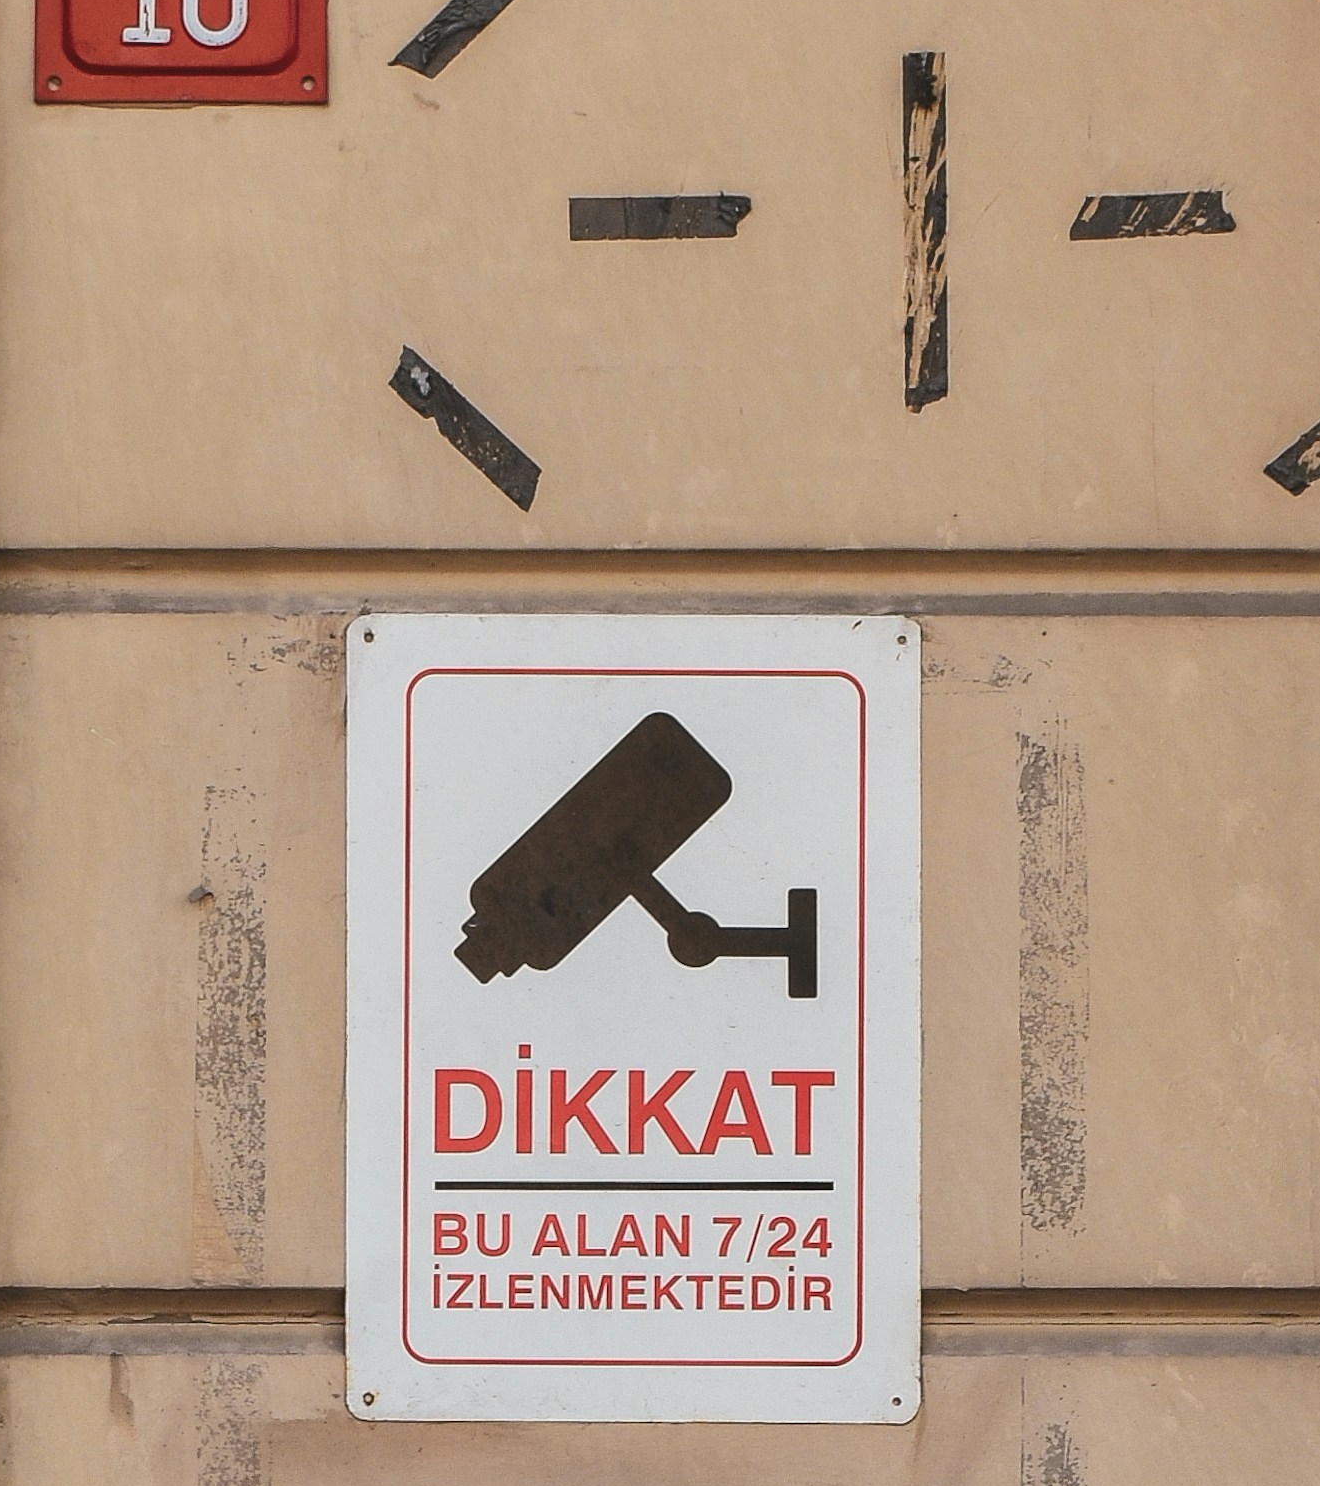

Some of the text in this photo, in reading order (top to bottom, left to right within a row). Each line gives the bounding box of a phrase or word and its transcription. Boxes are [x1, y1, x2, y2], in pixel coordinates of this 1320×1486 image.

[432, 1043, 836, 1157] DİKKAT
[432, 1212, 834, 1264] BU ALAN 7/24
[431, 1262, 834, 1312] İZLENMEKTEDİR
